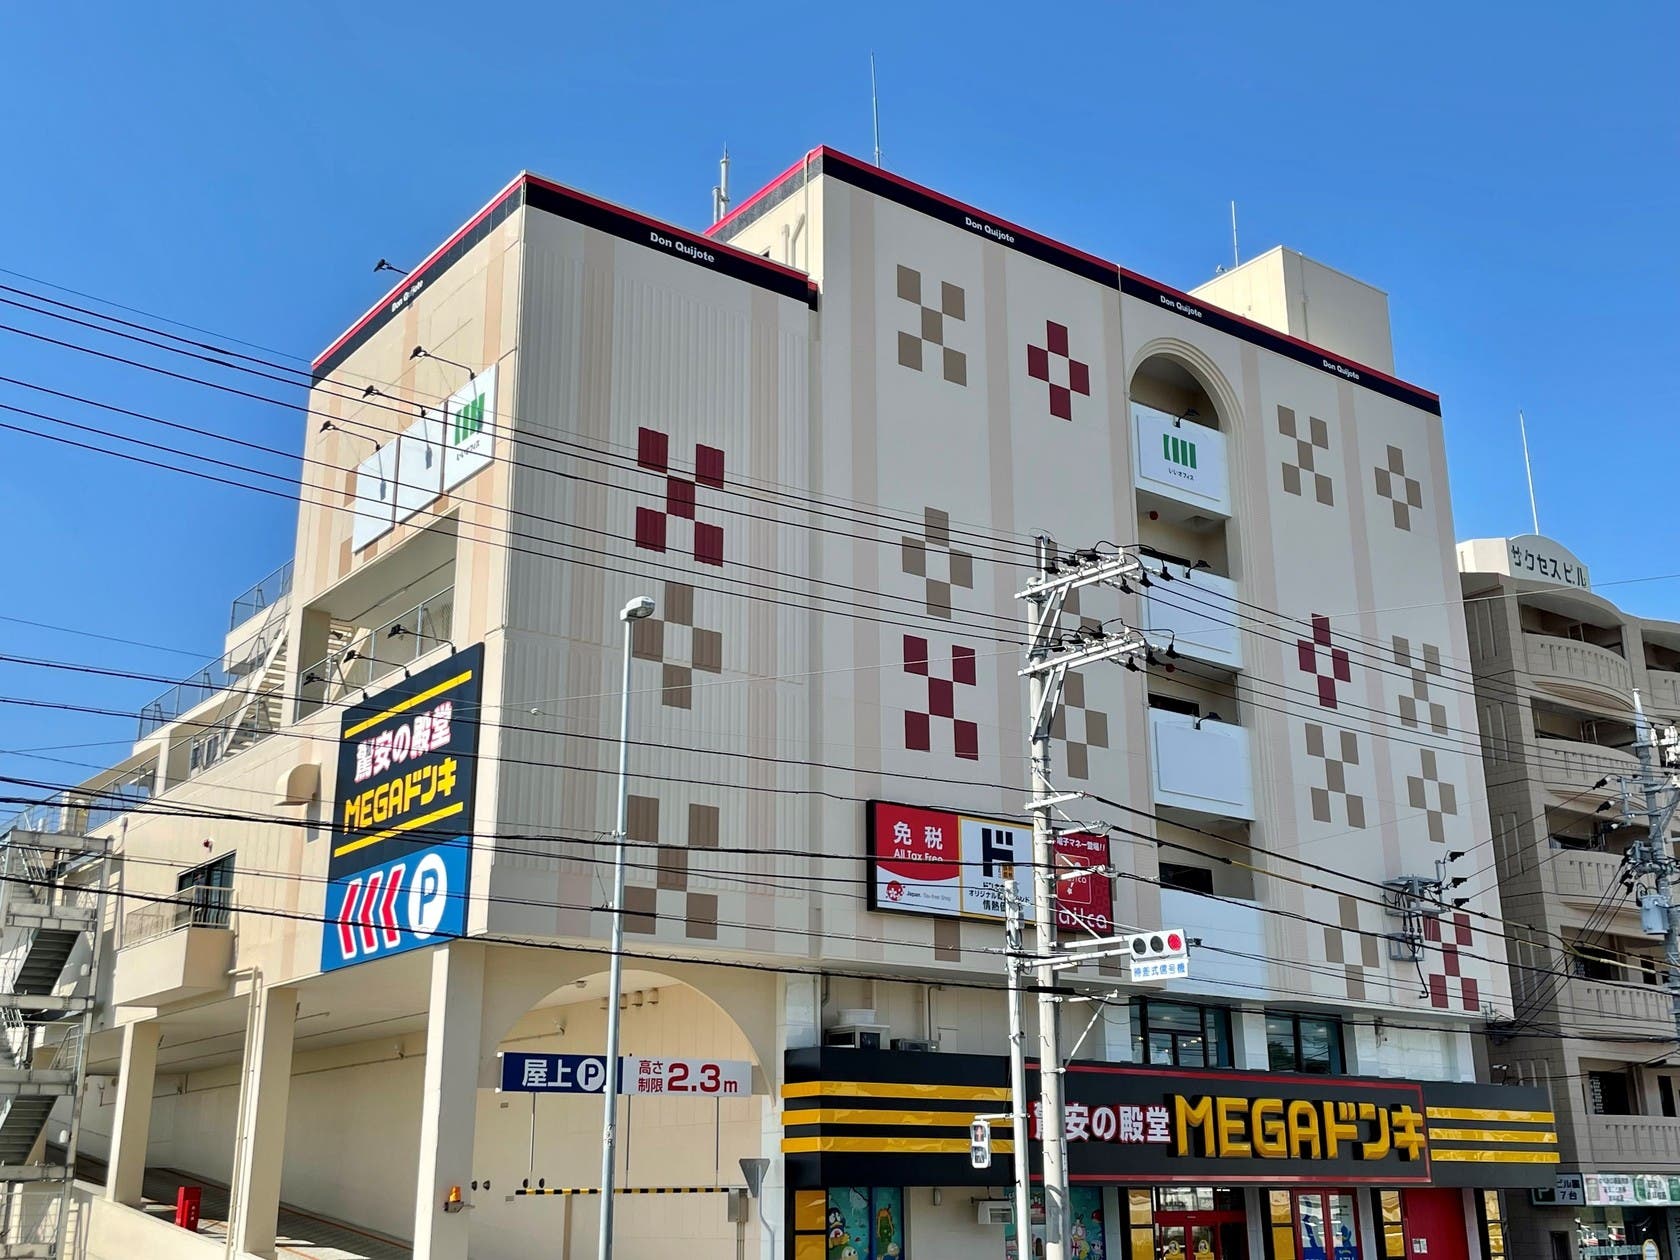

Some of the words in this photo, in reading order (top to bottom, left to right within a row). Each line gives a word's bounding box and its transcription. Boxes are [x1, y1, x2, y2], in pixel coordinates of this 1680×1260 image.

[965, 216, 983, 231] Don
[984, 225, 1015, 243] Quijote
[650, 231, 672, 248] Don
[675, 241, 715, 263] Quijote
[1160, 295, 1175, 308] Don
[1176, 301, 1203, 318] Quijote
[1322, 359, 1336, 371] Don
[1336, 365, 1360, 380] Quijote
[1511, 545, 1587, 587] サクセスビル
[343, 757, 457, 836] MEGAドンキ
[893, 821, 944, 850] 免税
[893, 848, 905, 859] All
[907, 850, 922, 861] Tax
[522, 1059, 572, 1088] 屋上
[639, 1060, 664, 1075] 高さ
[638, 1077, 663, 1093] 制限
[1174, 1094, 1426, 1161] MEGAドンキ
